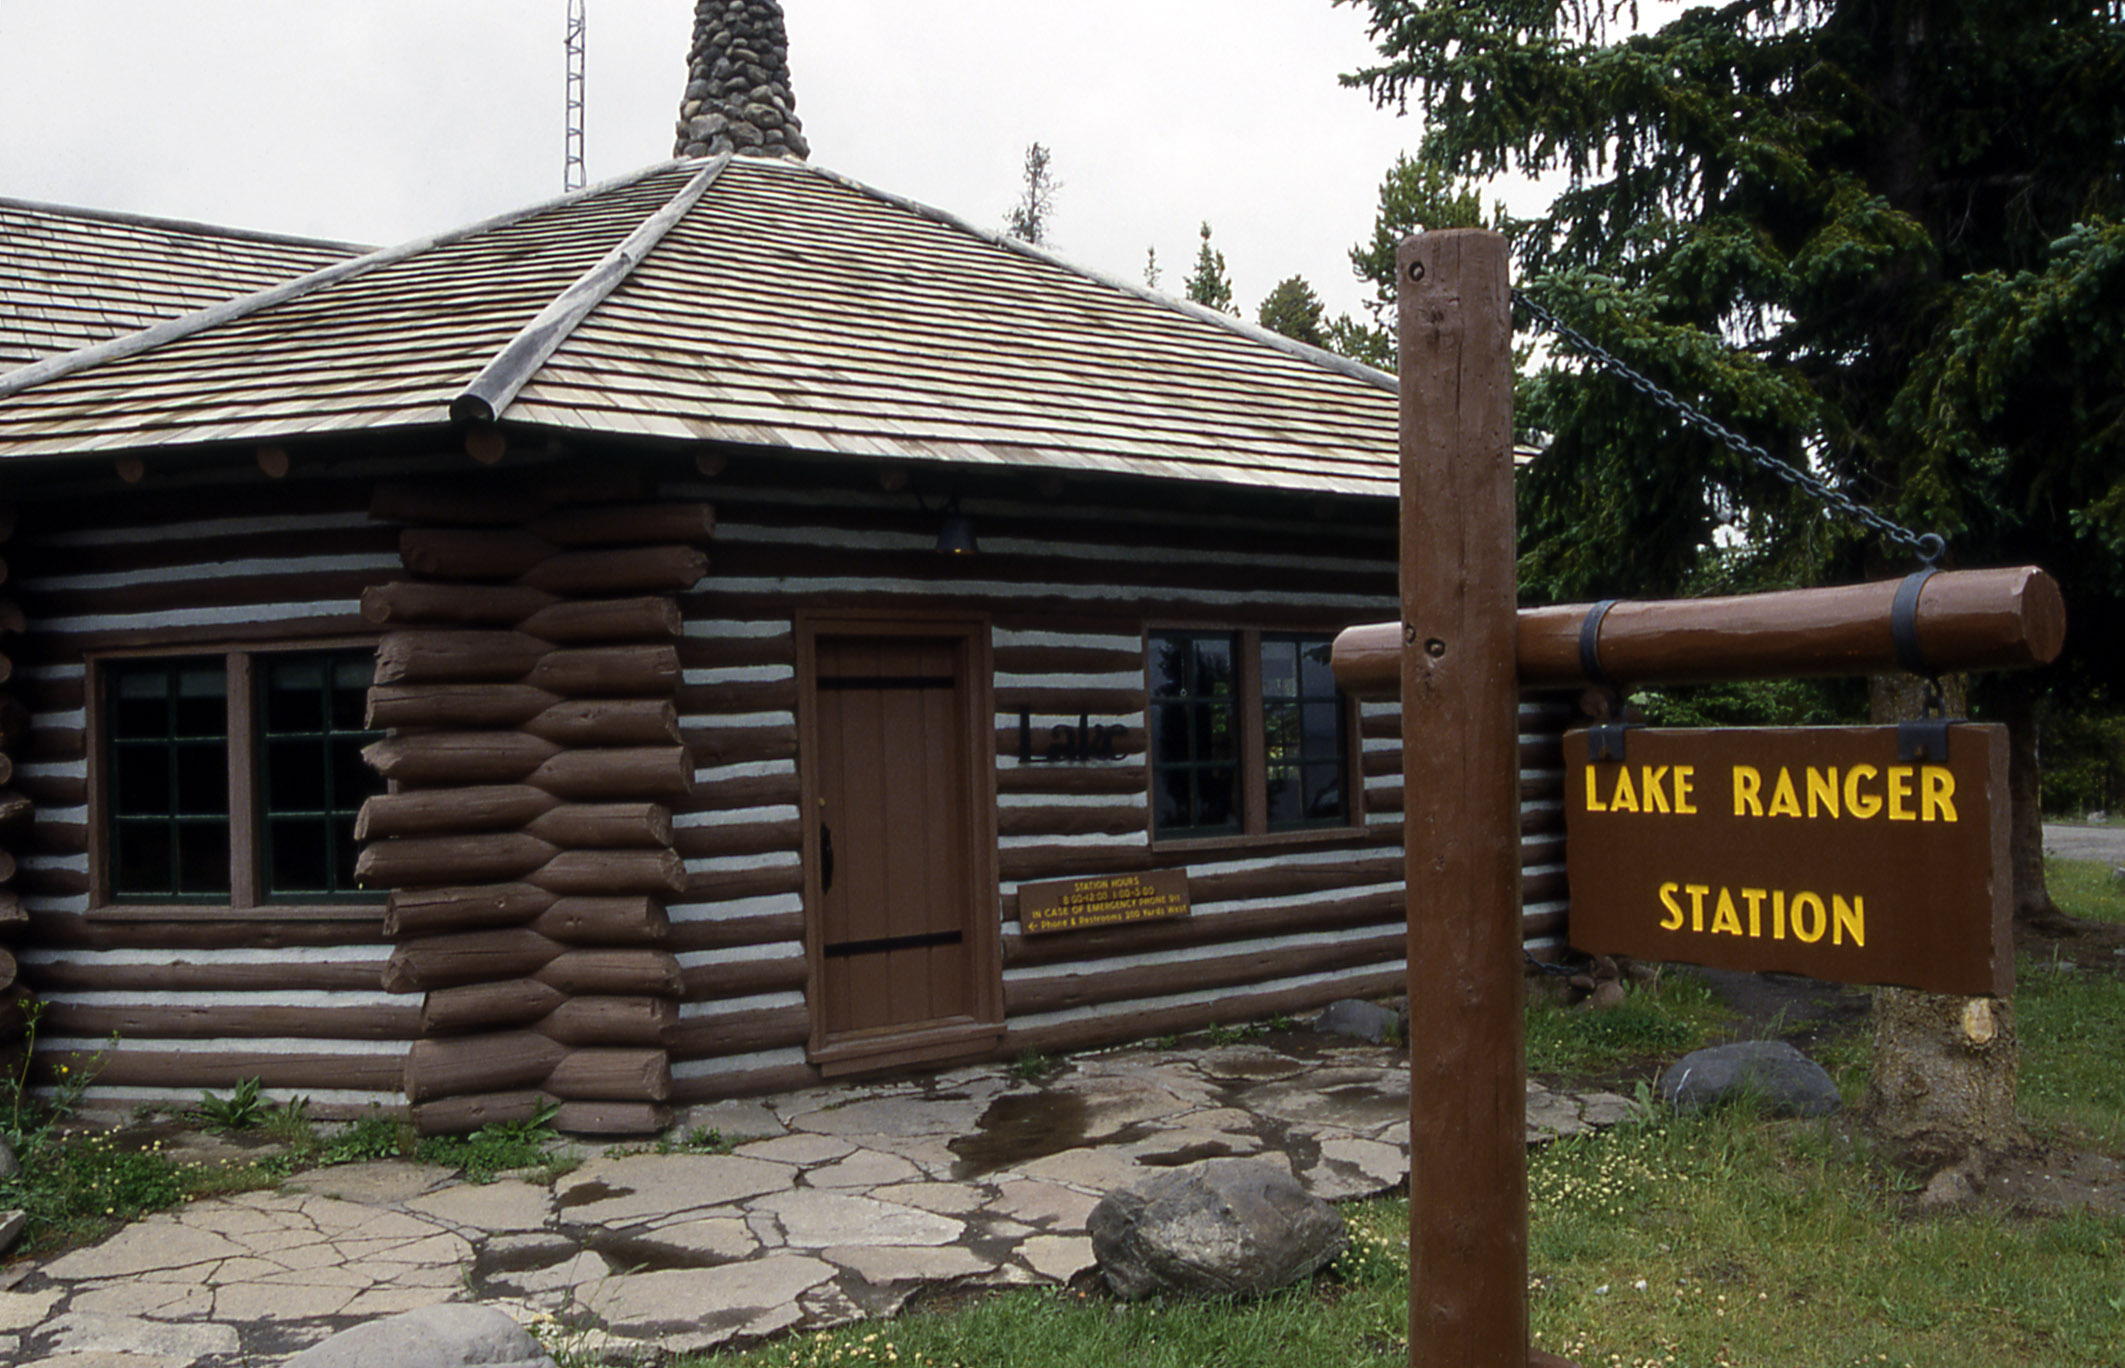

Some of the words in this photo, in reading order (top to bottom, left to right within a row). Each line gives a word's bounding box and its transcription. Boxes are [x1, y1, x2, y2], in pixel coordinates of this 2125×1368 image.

[1586, 764, 1697, 814] LAKE
[1732, 763, 1958, 822] RANGER
[1073, 879, 1109, 893] STATION
[1111, 876, 1140, 889] HOURS
[1032, 910, 1042, 919] IN
[1044, 905, 1069, 918] CASE
[1071, 903, 1083, 915] OF
[1087, 898, 1136, 913] EMERGENCY
[1138, 895, 1166, 907] PHONE
[1168, 893, 1181, 904] 911
[1041, 918, 1068, 930] Phone
[1078, 911, 1122, 925] Restrooms
[1142, 906, 1165, 918] Yards
[1167, 904, 1187, 916] West
[1659, 881, 1865, 947] STATION
